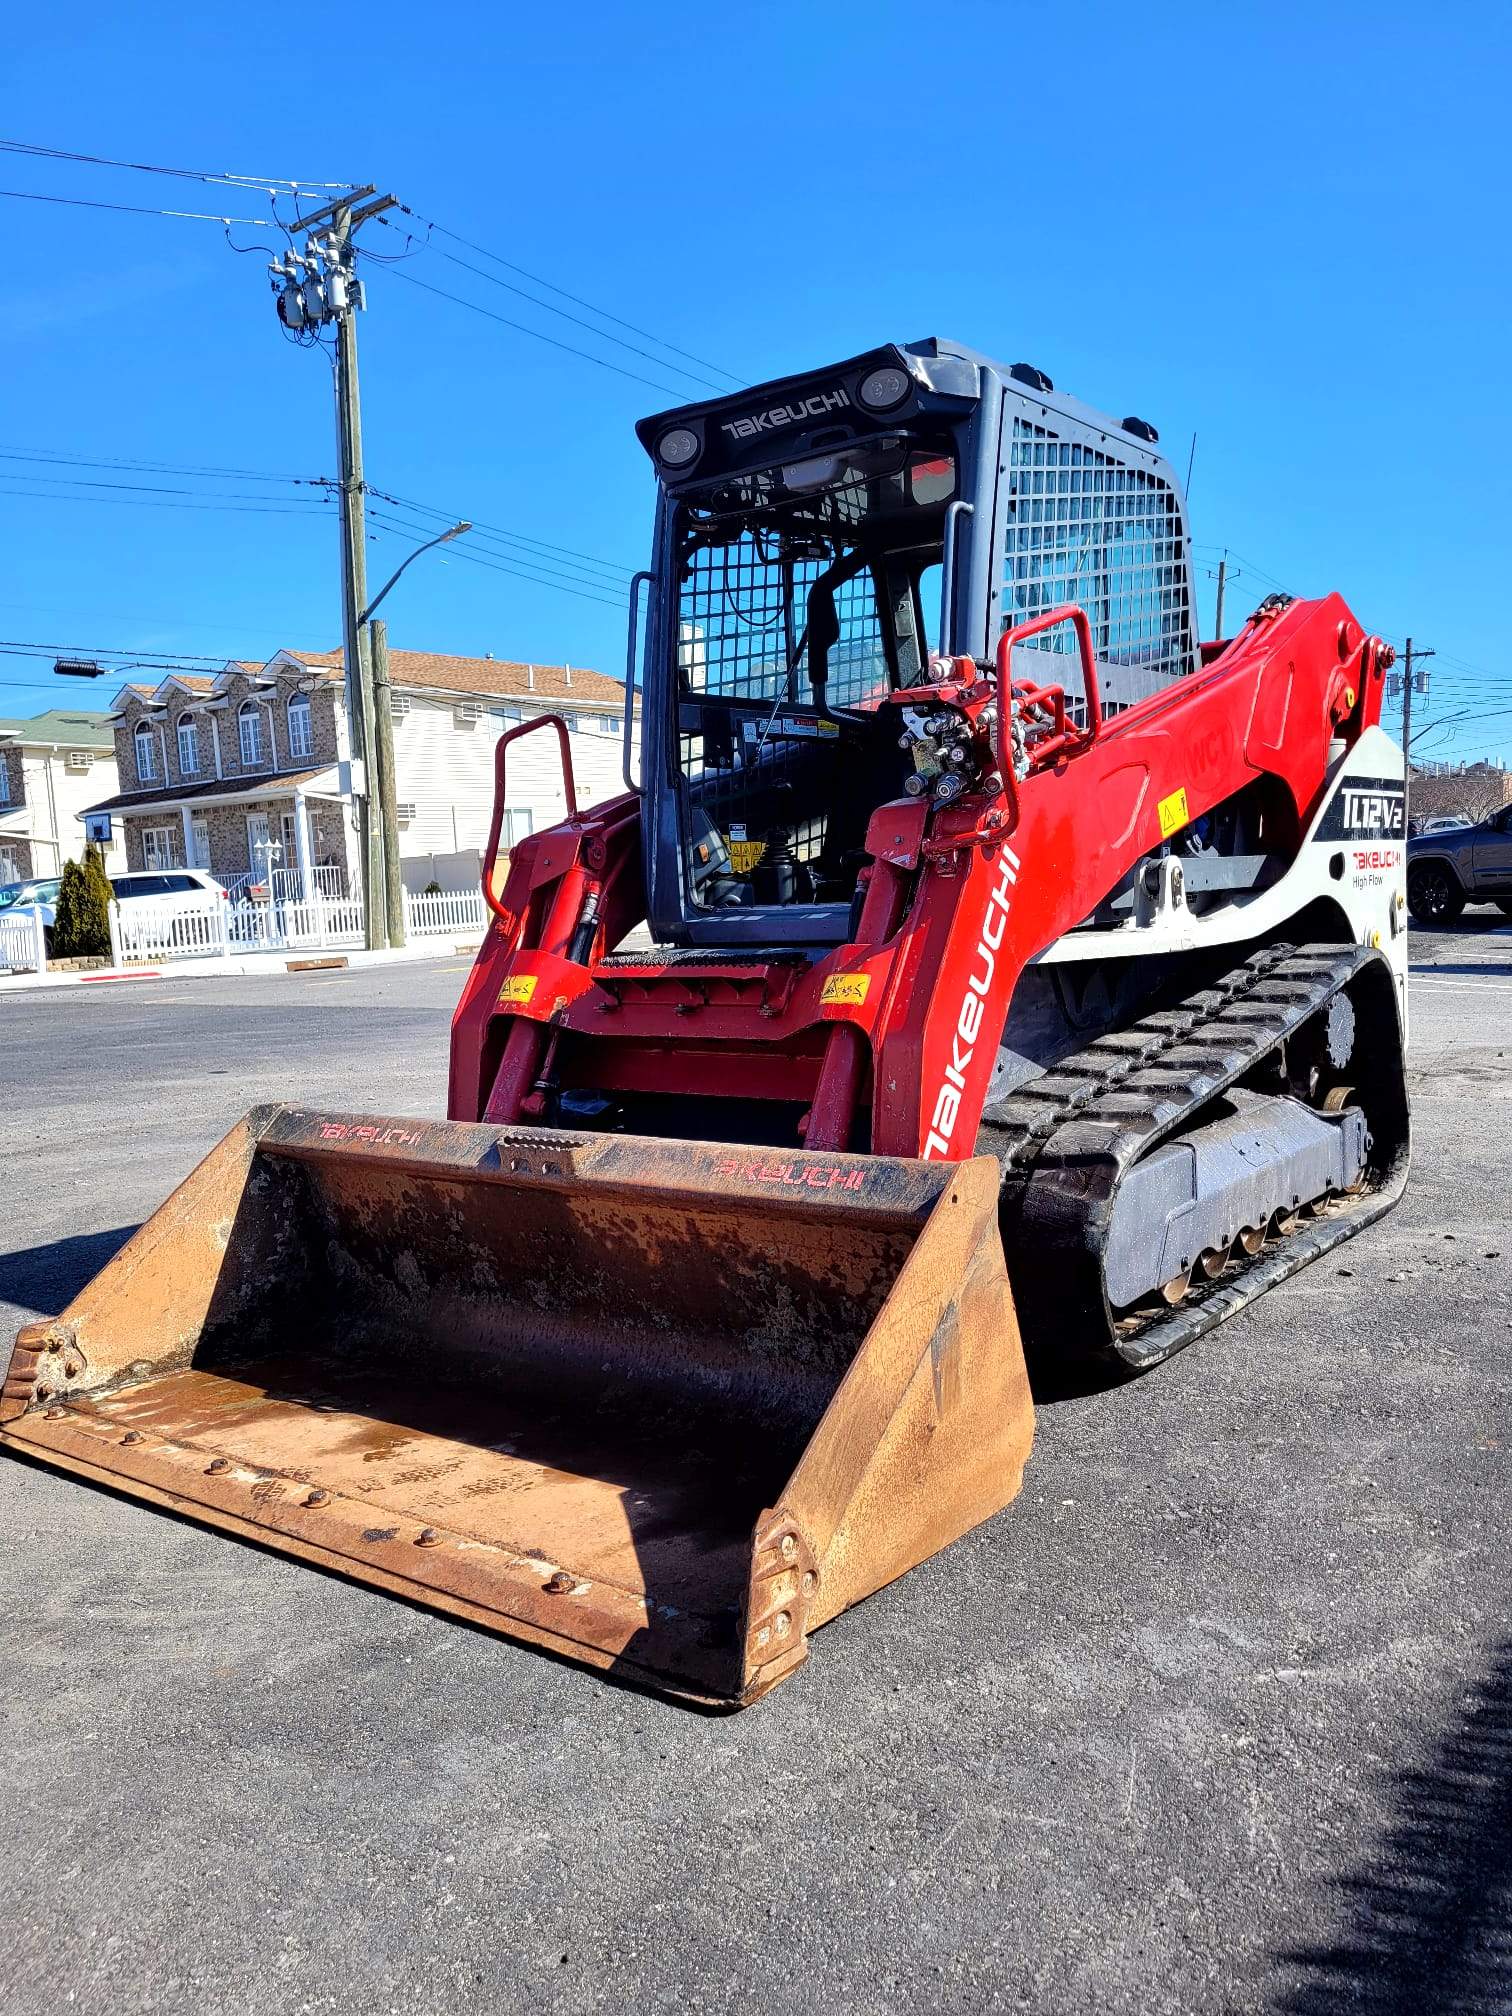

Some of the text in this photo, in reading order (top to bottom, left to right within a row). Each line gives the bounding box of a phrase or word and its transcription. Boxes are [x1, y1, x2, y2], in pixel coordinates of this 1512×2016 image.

[1352, 874, 1384, 890] High Flow
[714, 1158, 867, 1191] AKEUCHI
